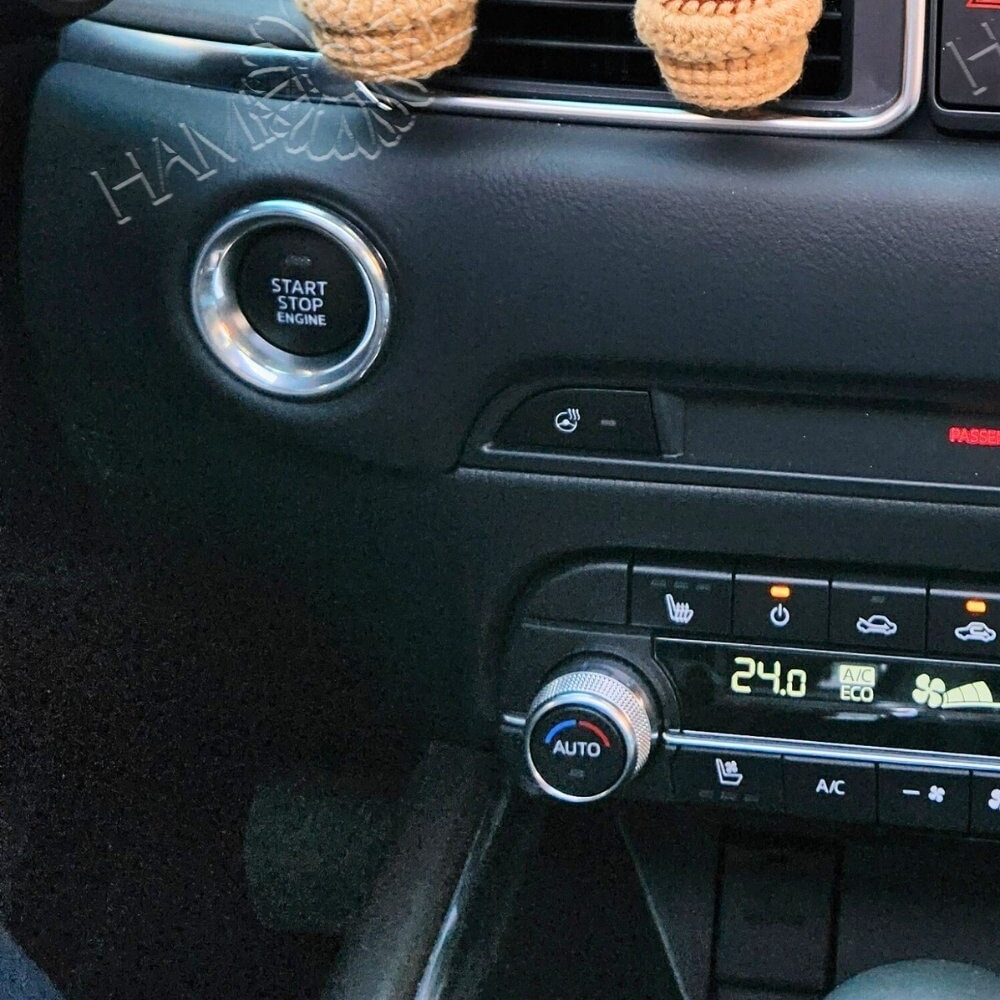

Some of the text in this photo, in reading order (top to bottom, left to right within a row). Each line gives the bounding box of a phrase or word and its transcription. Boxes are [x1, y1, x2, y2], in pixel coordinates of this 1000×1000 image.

[270, 277, 329, 297] START
[277, 295, 325, 313] STOP
[276, 310, 328, 327] ENGINE
[730, 656, 808, 699] 24.0
[841, 666, 874, 684] A/C
[840, 684, 875, 703] ECO
[552, 738, 602, 758] AUTO
[815, 778, 846, 796] A/C
